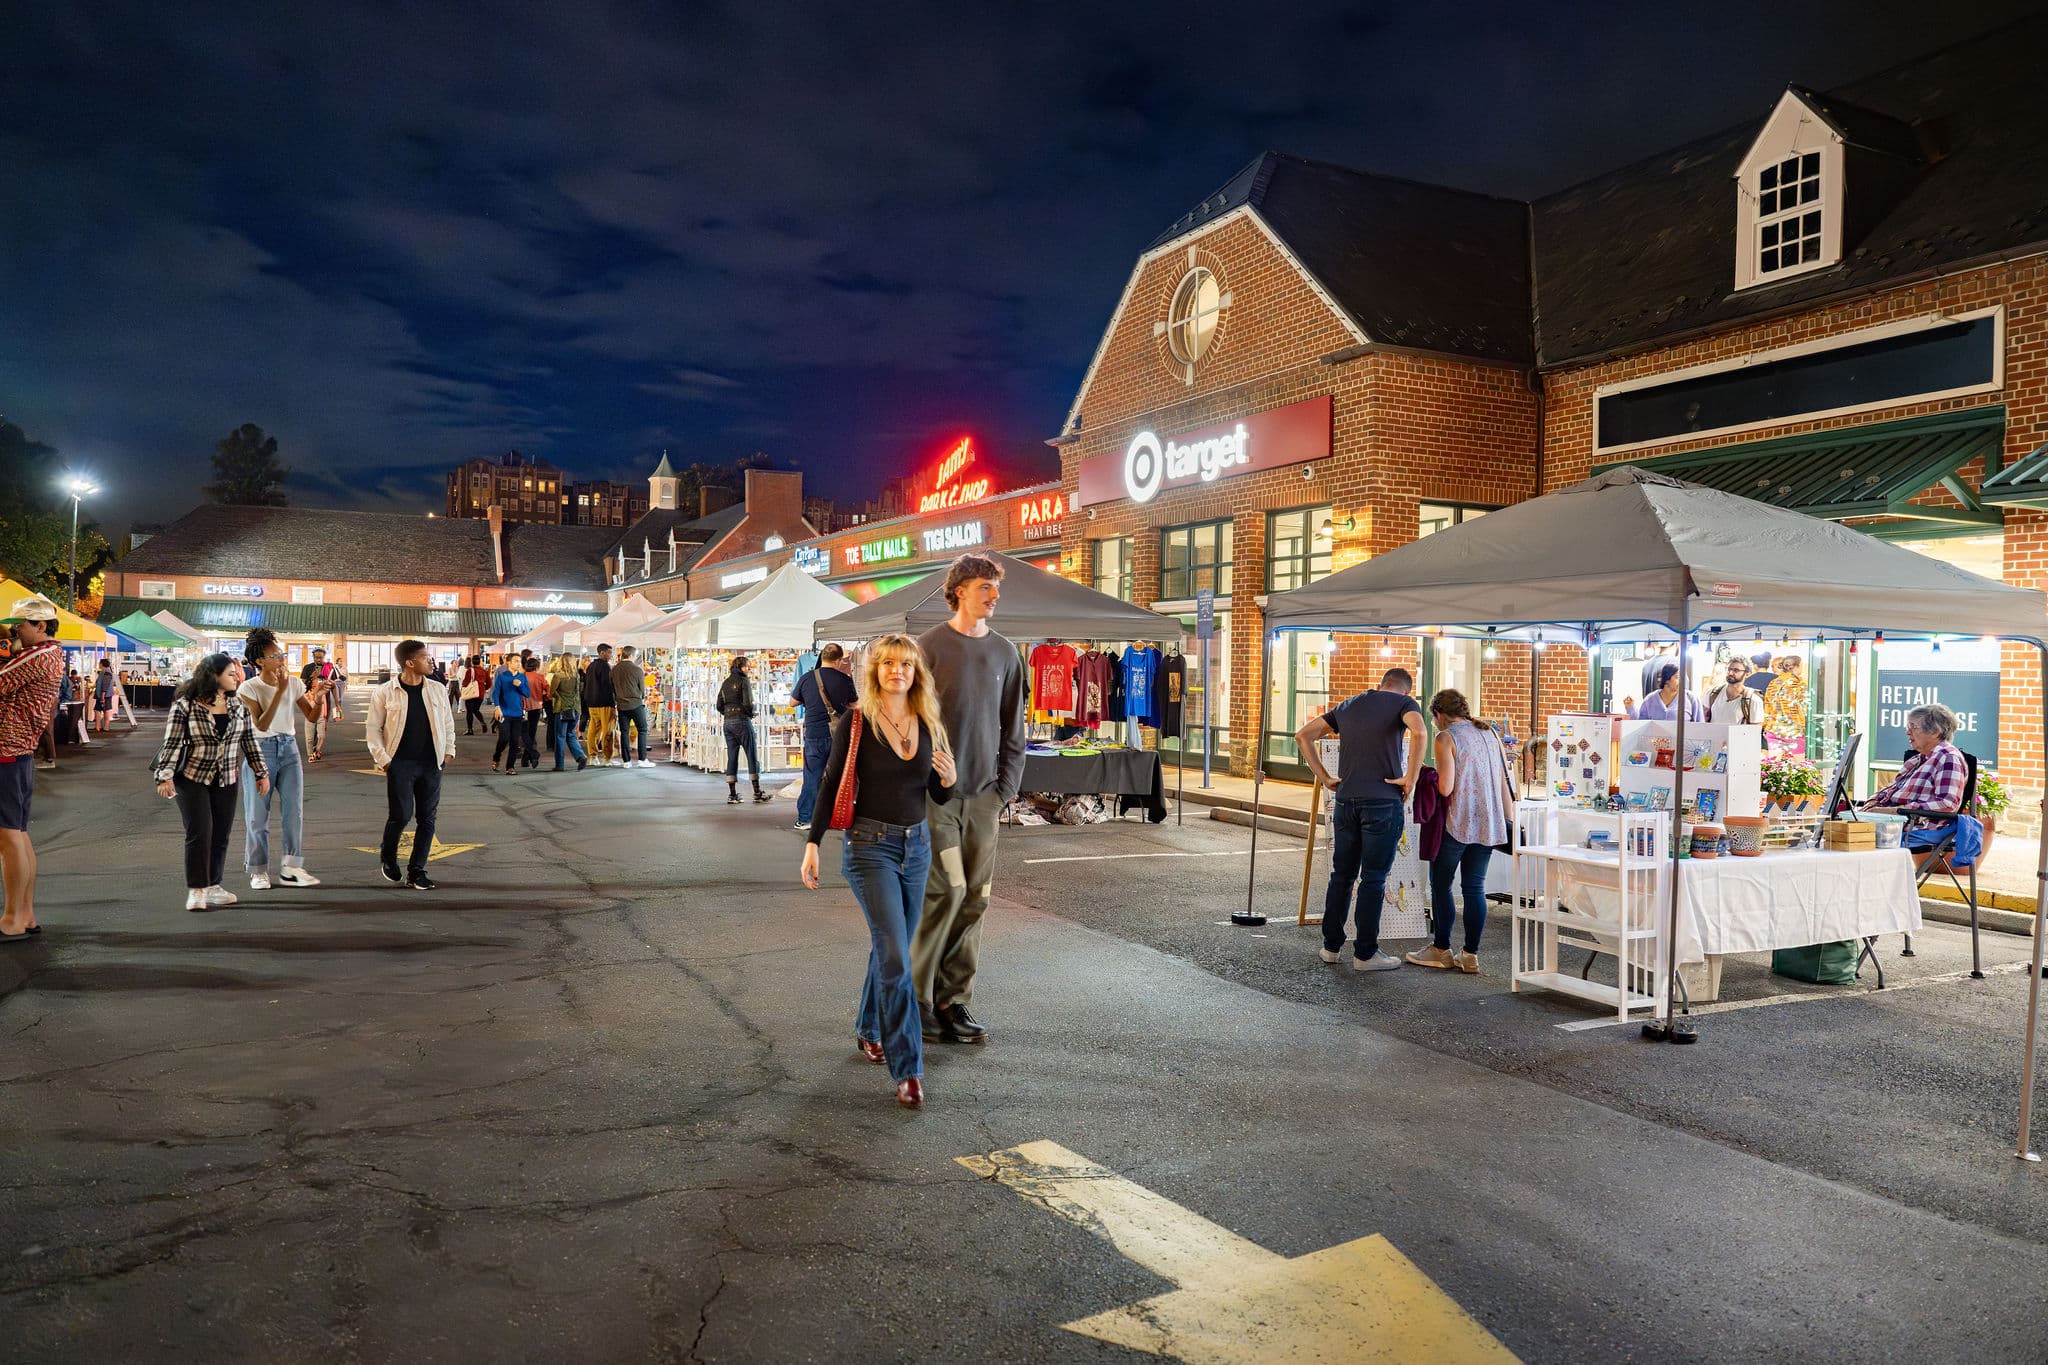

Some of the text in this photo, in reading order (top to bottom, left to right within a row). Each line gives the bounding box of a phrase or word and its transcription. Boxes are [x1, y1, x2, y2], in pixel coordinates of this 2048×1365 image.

[1165, 423, 1249, 482] target
[920, 490, 949, 514] PARK
[958, 479, 989, 505] SHOP
[923, 521, 982, 551] TIGI SALON
[1023, 526, 1043, 540] THAI
[845, 546, 860, 565] TOE
[860, 541, 883, 563] TALLY
[883, 536, 908, 559] NAILS
[204, 584, 249, 595] CHASE
[1881, 685, 1941, 705] RETAIL
